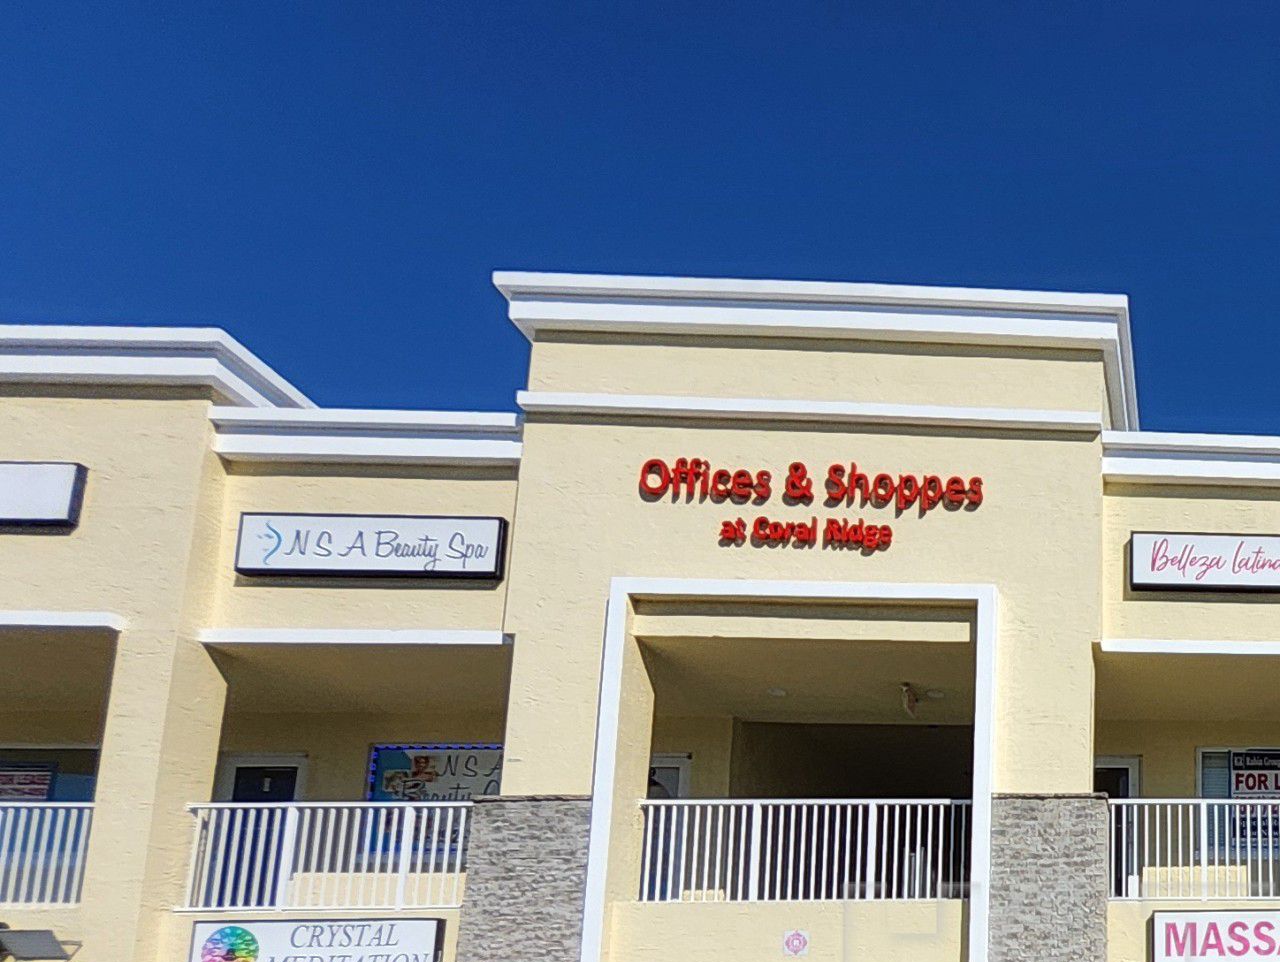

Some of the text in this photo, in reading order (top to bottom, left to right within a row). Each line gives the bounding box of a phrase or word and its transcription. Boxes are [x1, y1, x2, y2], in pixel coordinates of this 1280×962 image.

[639, 457, 984, 516] Offices & Shoppes
[375, 530, 441, 571] Beauty
[445, 531, 490, 569] Spa
[719, 515, 893, 555] at Coral Ridge
[1150, 538, 1227, 581] Belleza
[1235, 773, 1269, 791] FOR
[290, 923, 400, 949] CRYSTAL
